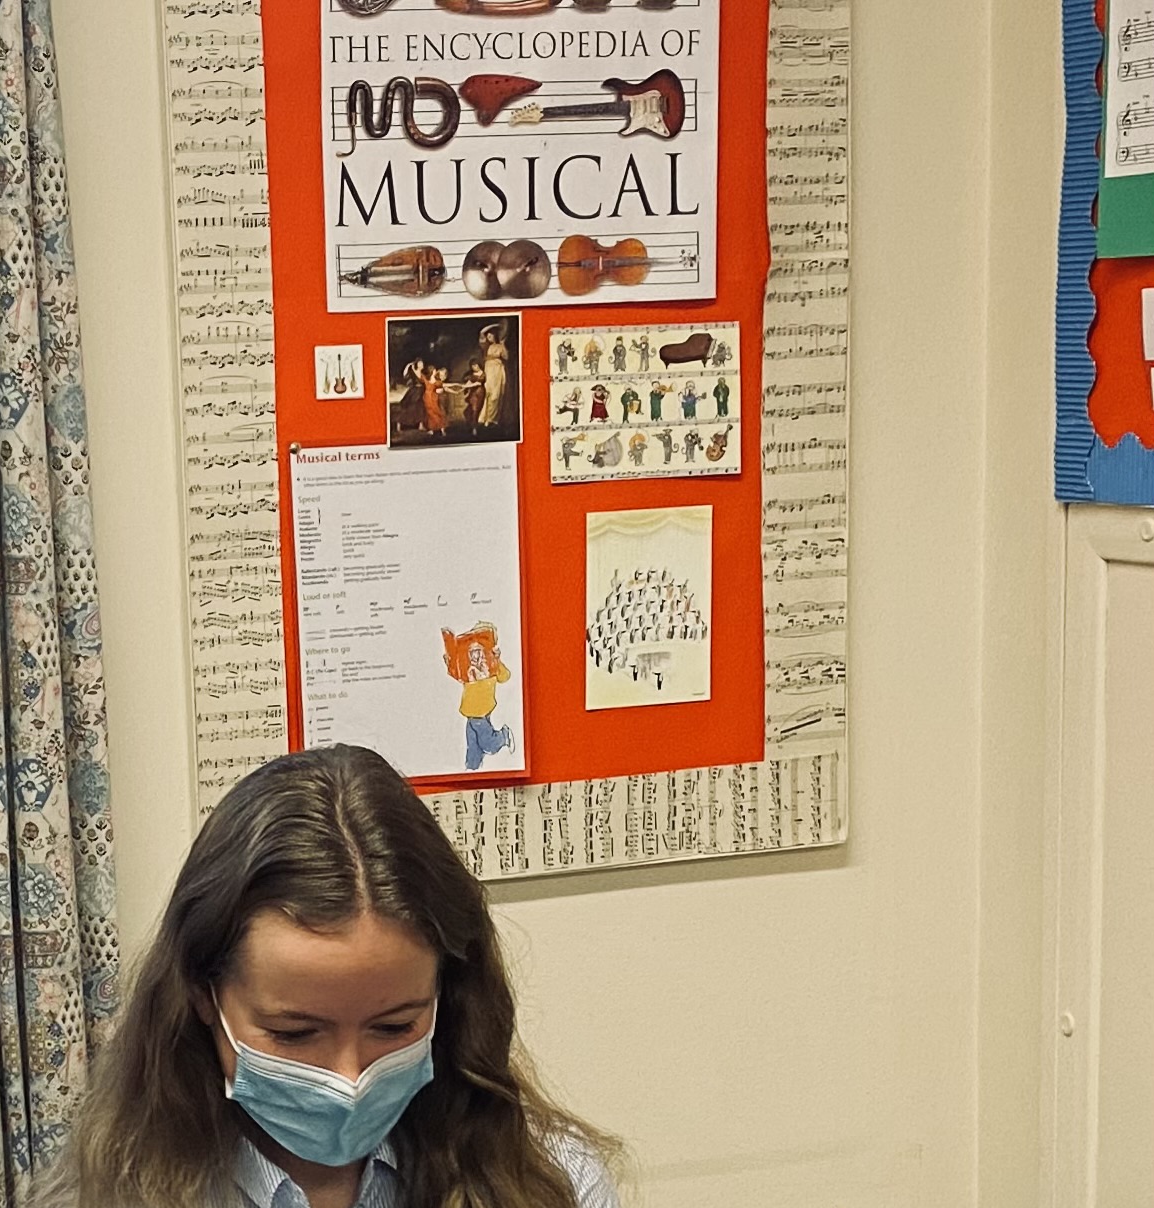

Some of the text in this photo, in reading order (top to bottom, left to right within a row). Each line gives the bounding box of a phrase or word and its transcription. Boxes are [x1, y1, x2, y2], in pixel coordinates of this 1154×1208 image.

[330, 29, 701, 63] THE ENCYCLOPEDIA OF
[335, 152, 700, 227] MUSICAL
[296, 452, 381, 464] Musical terms
[298, 496, 321, 504] Speed
